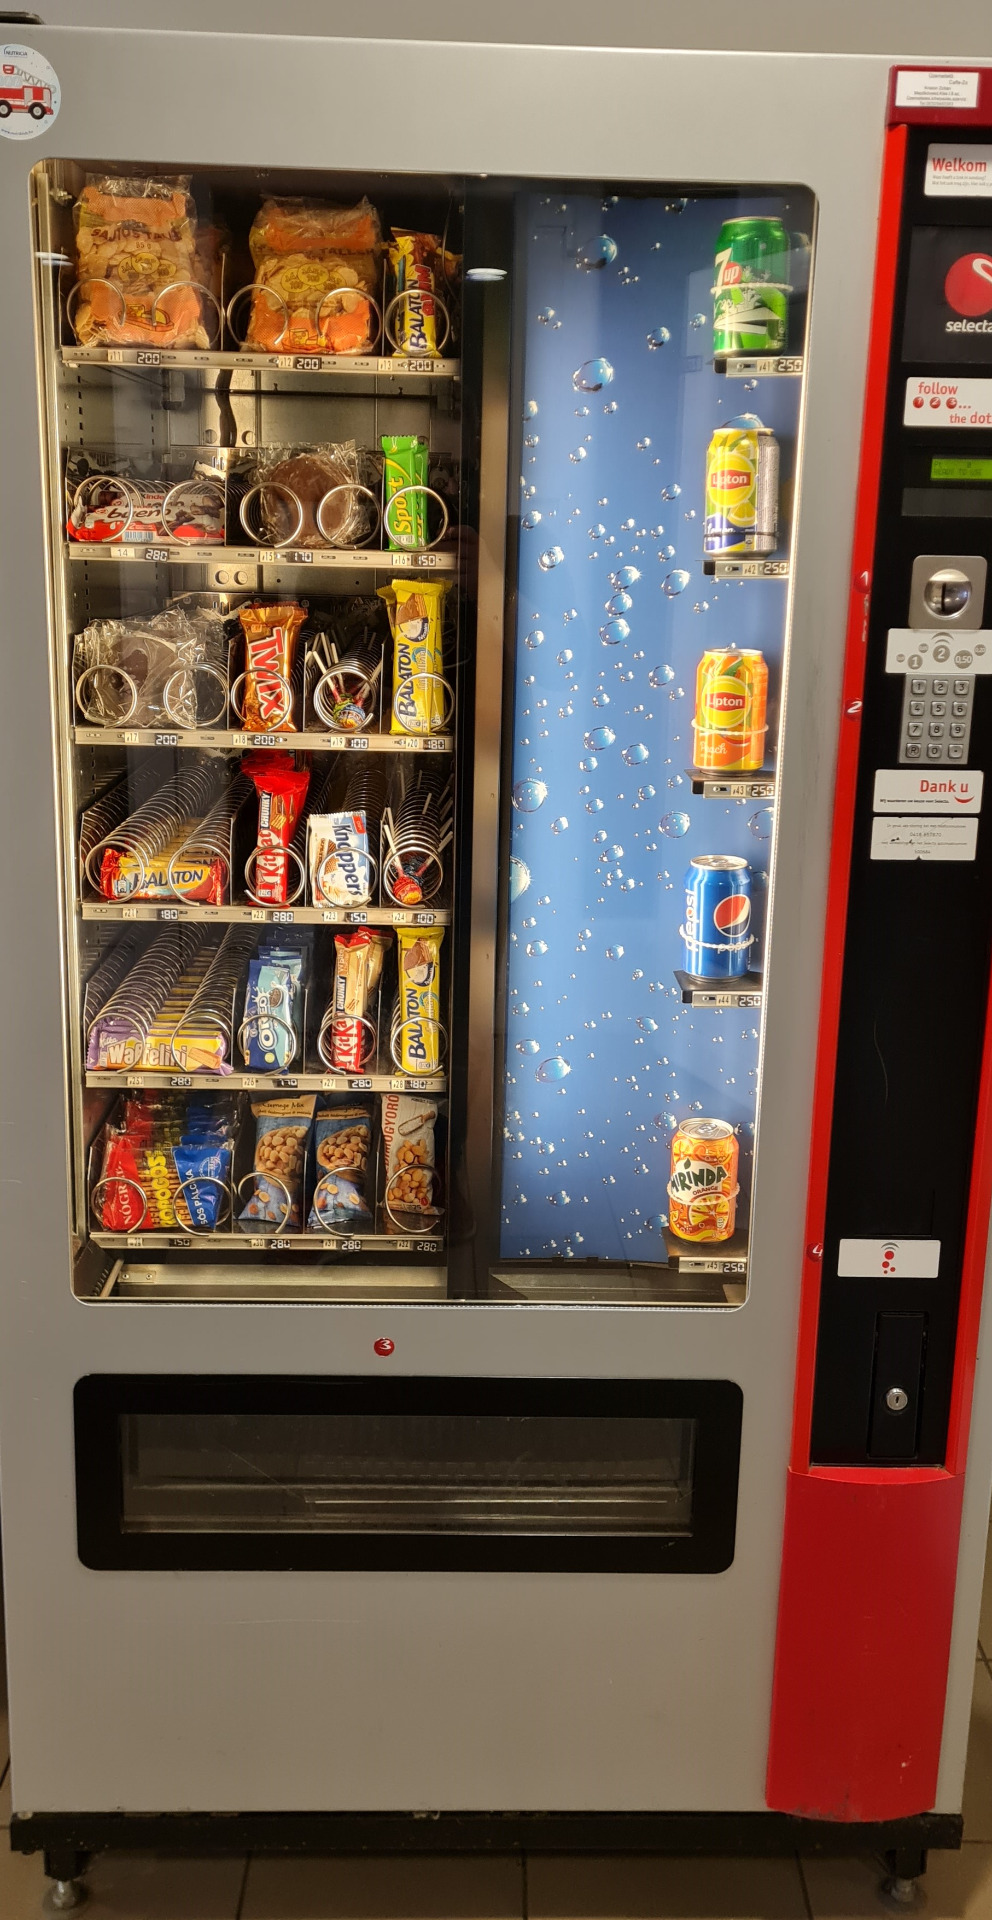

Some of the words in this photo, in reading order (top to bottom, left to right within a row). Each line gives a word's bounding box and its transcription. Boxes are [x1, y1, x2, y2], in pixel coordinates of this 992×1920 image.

[932, 157, 987, 172] Welkom
[946, 320, 992, 333] selecta
[138, 352, 160, 365] 200
[296, 358, 320, 370] 200
[410, 360, 431, 371] 200
[778, 359, 802, 371] 250
[918, 382, 958, 395] follow
[950, 413, 966, 424] the
[712, 473, 748, 486] Lipton
[388, 476, 412, 535] Sport
[107, 507, 171, 519] bueno
[117, 549, 128, 557] 14
[294, 552, 312, 562] 170
[418, 555, 436, 566] 150
[764, 562, 788, 574] 250
[860, 571, 869, 586] 1
[912, 656, 919, 667] 1
[938, 647, 946, 659] 2
[249, 626, 287, 720] TWIX
[398, 643, 417, 718] BALATON
[938, 683, 944, 691] 2
[706, 696, 743, 709] Lipton
[847, 701, 862, 714] 2
[936, 704, 942, 712] 5
[957, 705, 963, 713] 6
[912, 725, 919, 733] 7
[934, 725, 940, 733] 8
[955, 726, 961, 734] 9
[155, 735, 177, 745] 200
[254, 736, 275, 746] 200
[351, 739, 368, 749] 100
[428, 740, 445, 750] 180
[931, 747, 937, 755] 0
[751, 785, 775, 797] 250
[920, 780, 956, 793] Dank
[960, 783, 969, 793] u
[261, 793, 271, 829] CHUNKY
[332, 824, 363, 896] Knoppers
[132, 869, 203, 891] BALATON
[161, 909, 178, 920] 180
[351, 912, 367, 923] 150
[417, 914, 434, 924] 100
[685, 888, 699, 952] pepsi
[336, 976, 346, 1010] CHUNKY
[739, 996, 761, 1007] 250
[257, 995, 275, 1048] OREO
[405, 988, 427, 1060] BALATON
[108, 1042, 187, 1068] Waffelini
[171, 1077, 191, 1086] 280
[280, 1078, 297, 1087] 170
[352, 1079, 372, 1088] 280
[411, 1081, 426, 1089] 180
[671, 1162, 728, 1193] MIRINDA
[692, 1186, 719, 1196] ORANGE
[342, 1241, 361, 1250] 280
[417, 1242, 437, 1252] 280
[812, 1244, 823, 1257] 4
[724, 1262, 745, 1273] 250
[379, 1339, 392, 1350] 3
